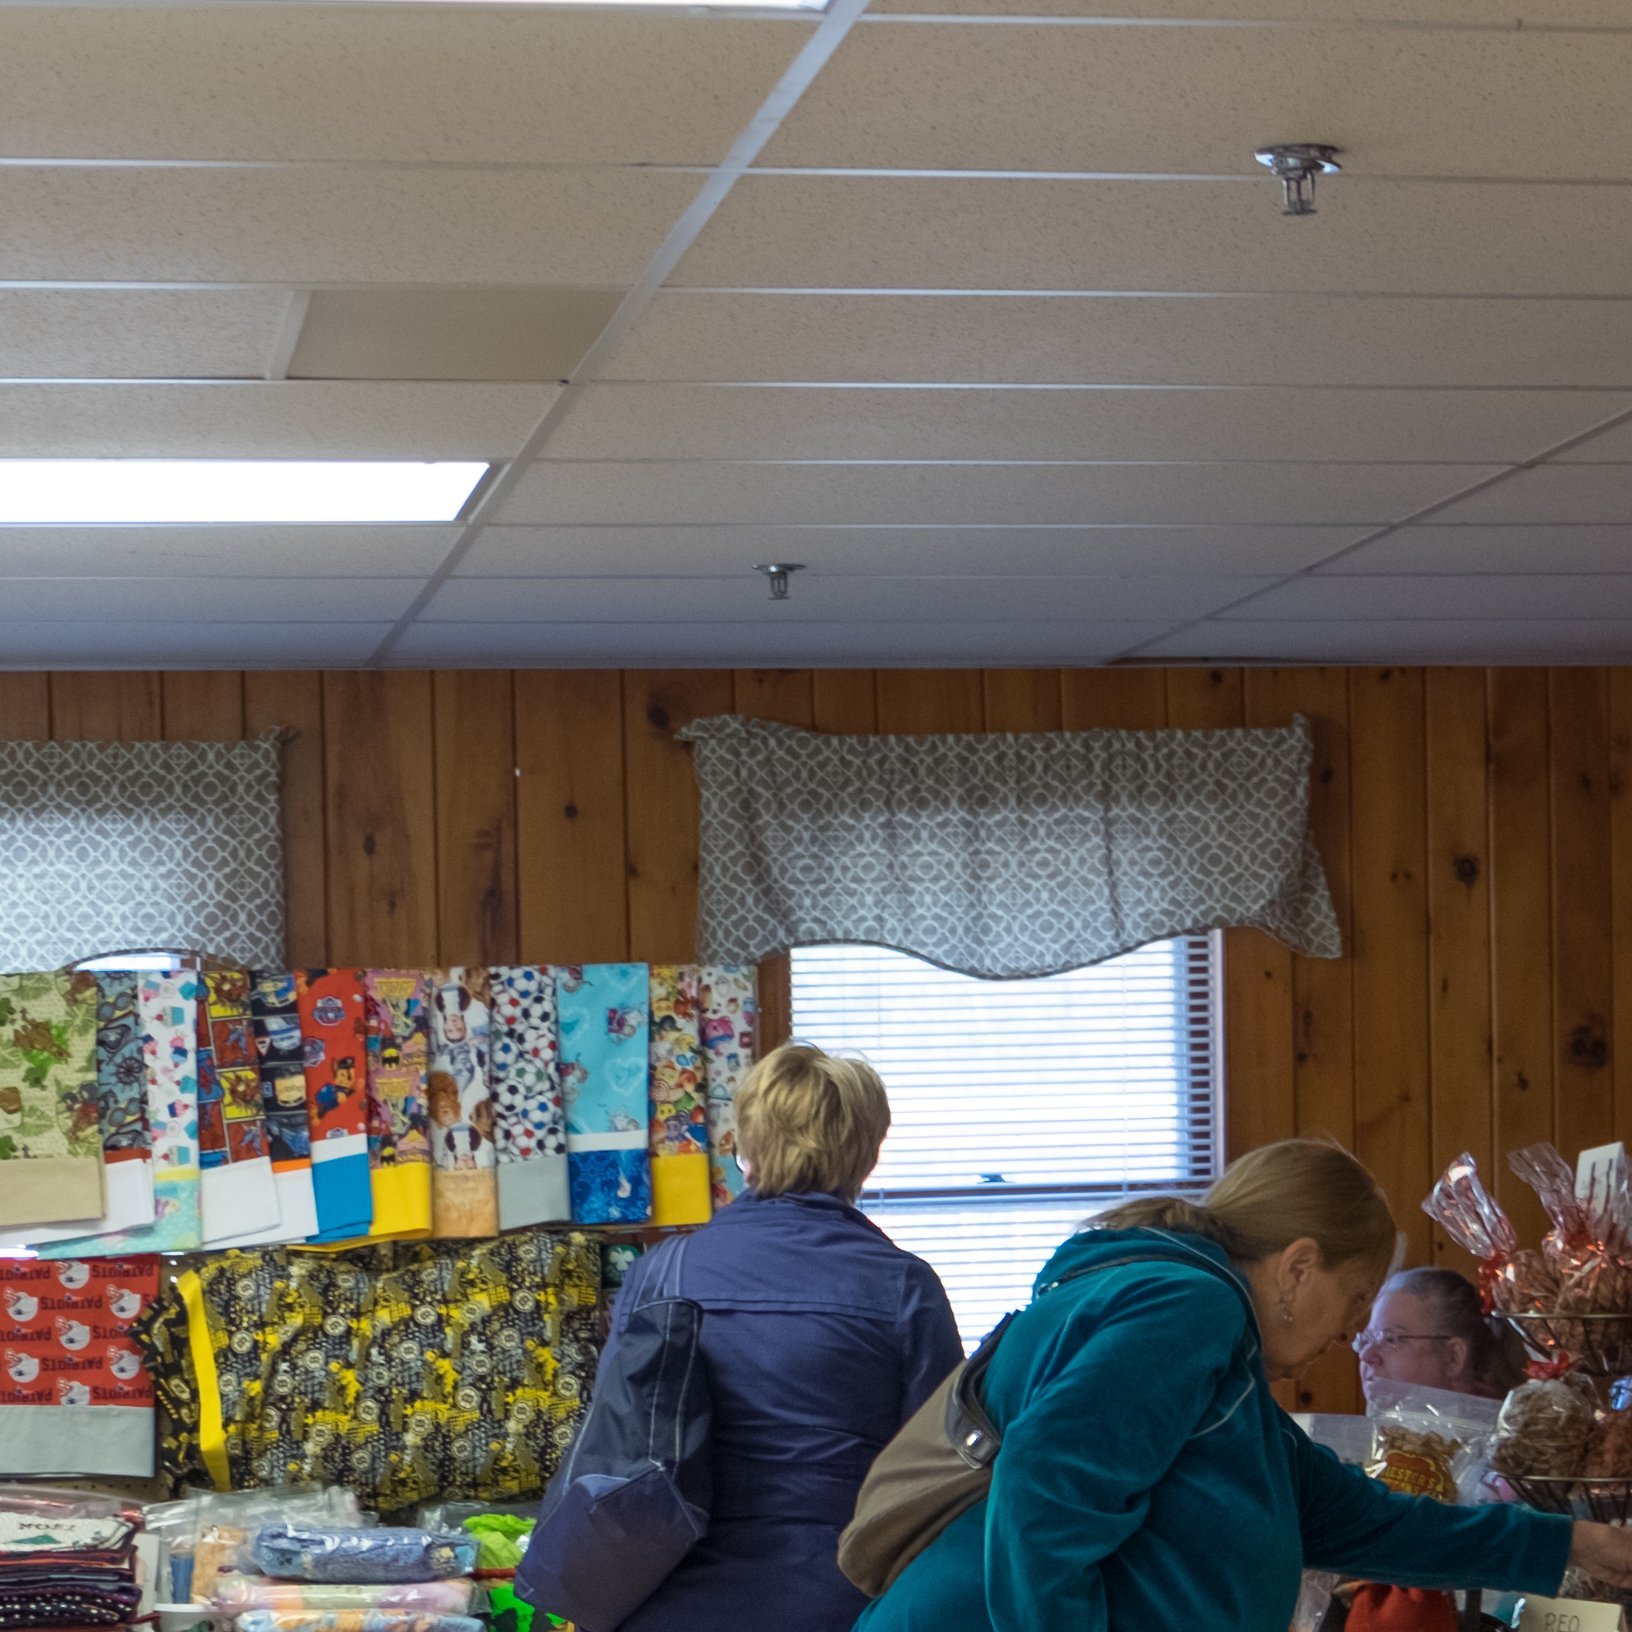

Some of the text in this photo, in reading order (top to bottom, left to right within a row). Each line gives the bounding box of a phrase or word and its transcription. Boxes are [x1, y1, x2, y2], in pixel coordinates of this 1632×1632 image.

[92, 1264, 153, 1278] PATRIOTS
[41, 1296, 102, 1310] PATRIOTS
[41, 1357, 103, 1371] PATRIOTS
